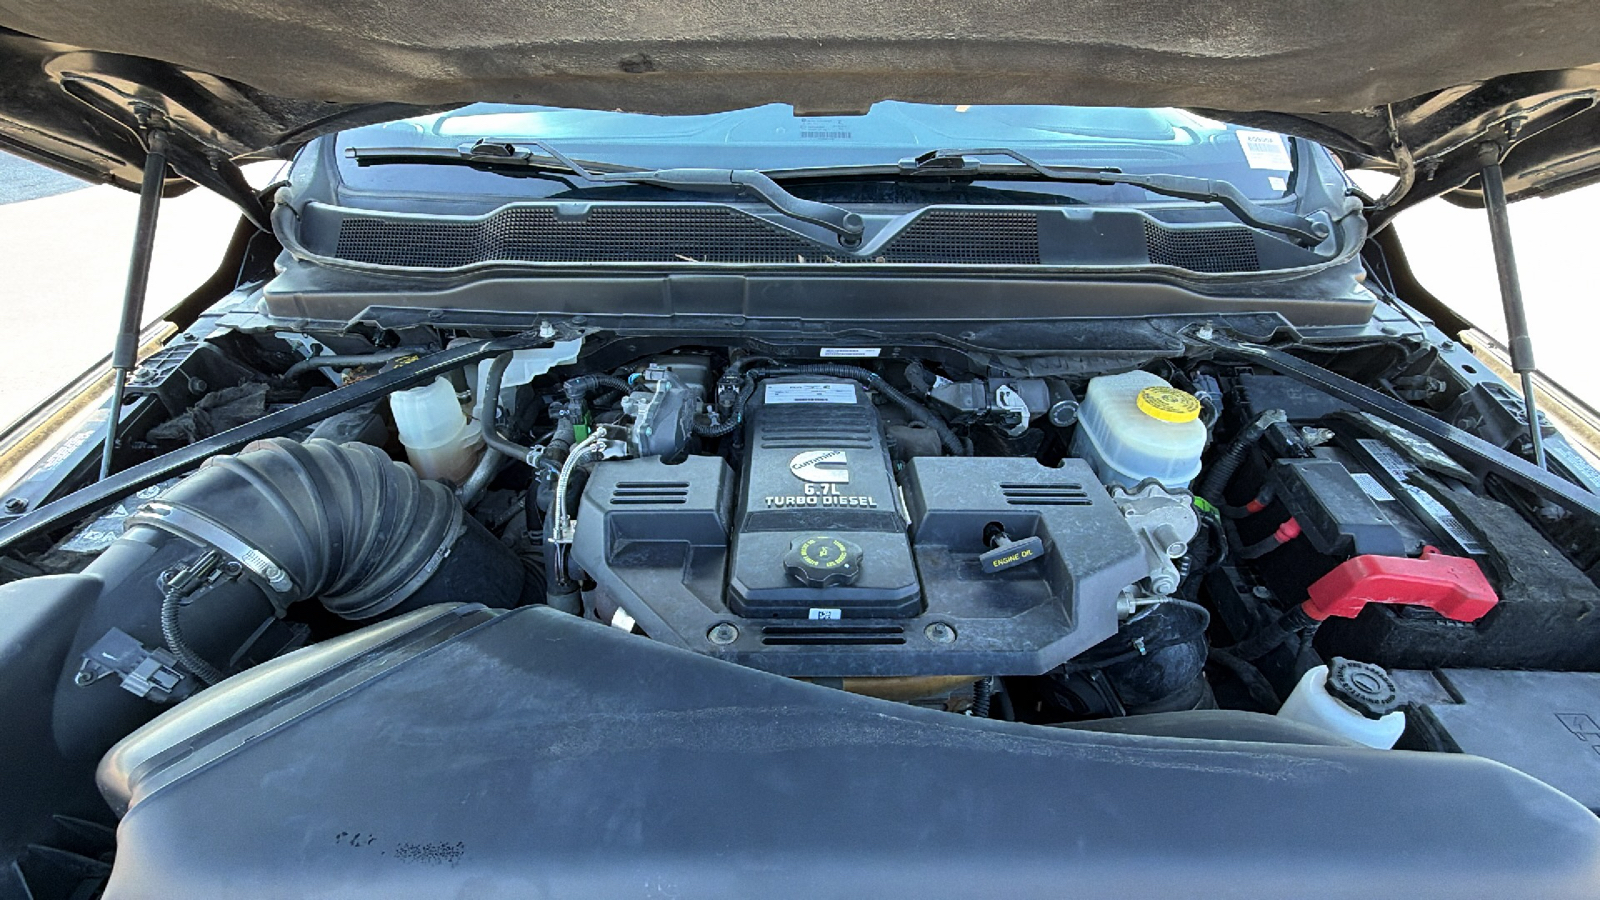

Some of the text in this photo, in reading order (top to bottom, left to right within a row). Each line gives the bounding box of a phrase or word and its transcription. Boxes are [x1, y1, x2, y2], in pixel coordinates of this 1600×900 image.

[791, 450, 841, 470] Cummins
[804, 483, 840, 496] 6.7L
[765, 496, 878, 508] TURBO DIESEL
[992, 549, 1033, 567] ENGINE OIL
